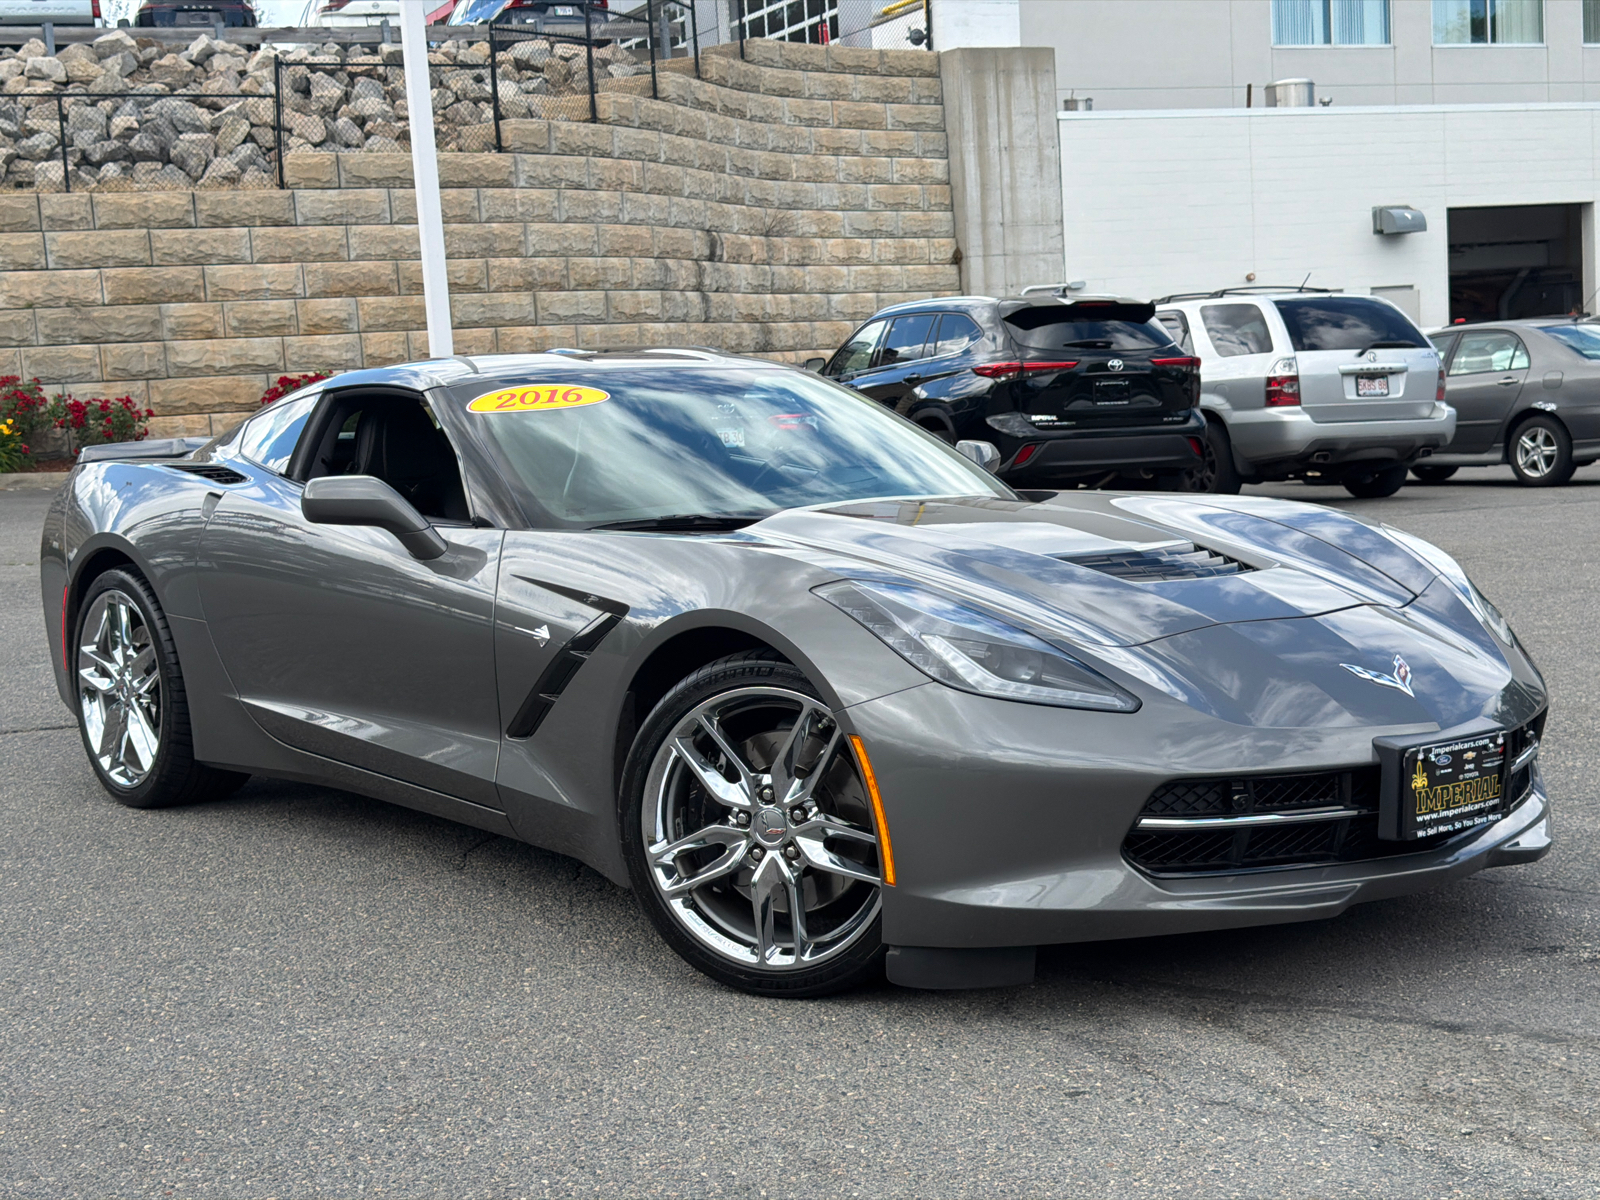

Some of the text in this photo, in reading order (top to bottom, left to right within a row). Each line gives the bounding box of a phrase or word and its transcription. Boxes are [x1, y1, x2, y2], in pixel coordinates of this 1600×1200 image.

[495, 387, 583, 410] 2016
[1432, 739, 1490, 755] Imperialcars.com
[1463, 771, 1479, 779] TOYOTA
[1416, 774, 1501, 814] IMPERIAL
[1416, 798, 1500, 822] www.imperialcars.com
[1416, 830, 1427, 838] We
[1427, 827, 1438, 836] Sell
[1454, 821, 1462, 829] So
[1463, 819, 1473, 827] You
[1474, 816, 1487, 825] Save
[1488, 813, 1502, 821] More
